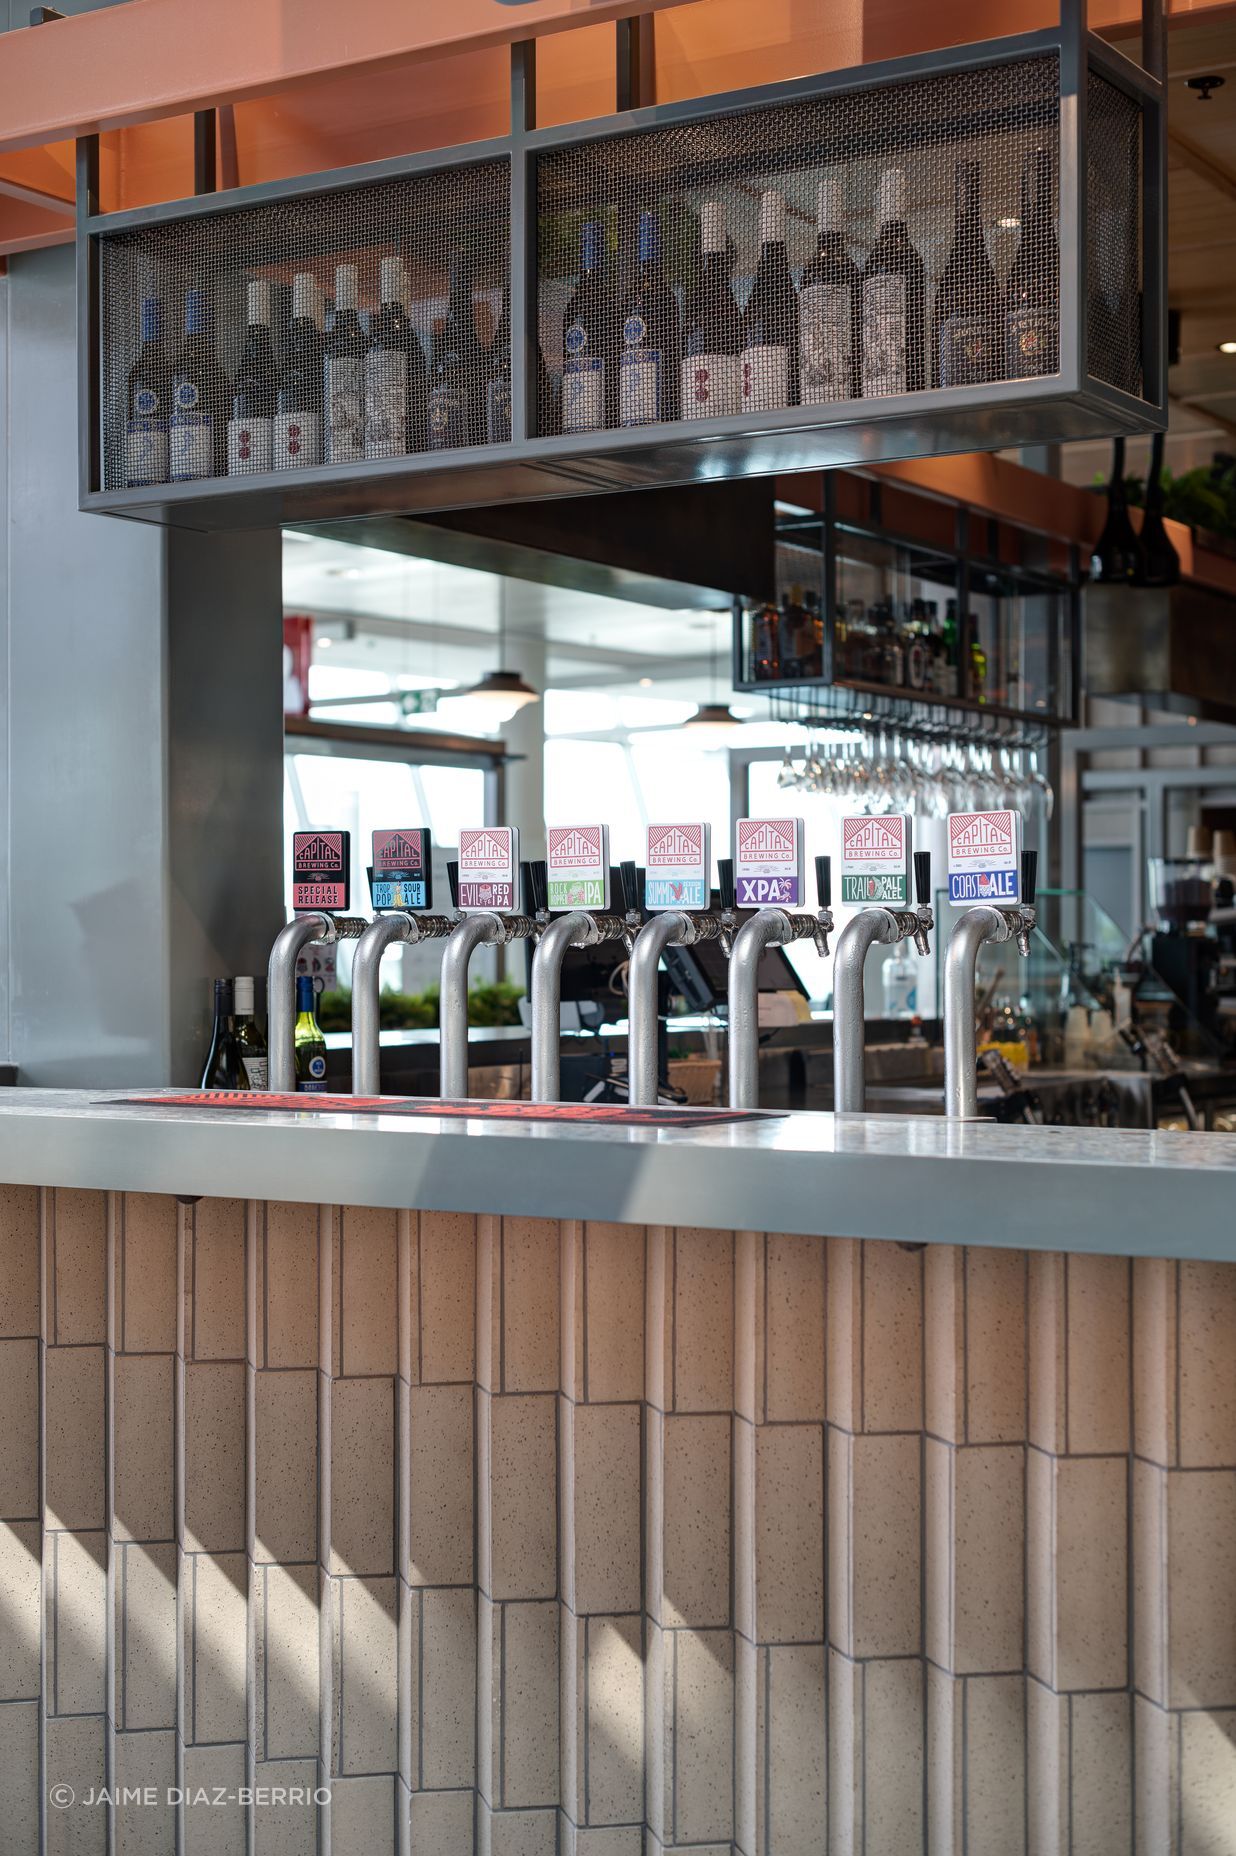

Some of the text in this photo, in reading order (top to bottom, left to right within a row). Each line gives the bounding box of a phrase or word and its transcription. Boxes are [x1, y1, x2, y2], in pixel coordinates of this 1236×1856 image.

[653, 829, 697, 854] CAPITAL
[744, 825, 789, 850] CAPITAL
[850, 822, 897, 847] CAPITAL
[957, 818, 1007, 845] CAPITAL
[299, 837, 338, 860] CAPITAL
[379, 834, 418, 858] CAPITAL
[465, 834, 505, 858] CAPITAL
[554, 831, 597, 856] CAPITAL
[848, 850, 886, 858] BREWING
[956, 847, 996, 855] BREWING
[298, 886, 338, 895] SPECIAL
[403, 884, 421, 893] SOUR
[460, 884, 481, 906] EVIL
[492, 884, 509, 895] RED
[584, 881, 602, 904] IPA
[682, 886, 702, 904] ALE
[742, 879, 781, 901] XPA
[844, 876, 870, 900] TRAIL
[952, 872, 1014, 899] COAST ALE
[298, 895, 338, 904] RELEASE
[376, 893, 421, 906] POP ALE
[492, 895, 509, 906] IPA
